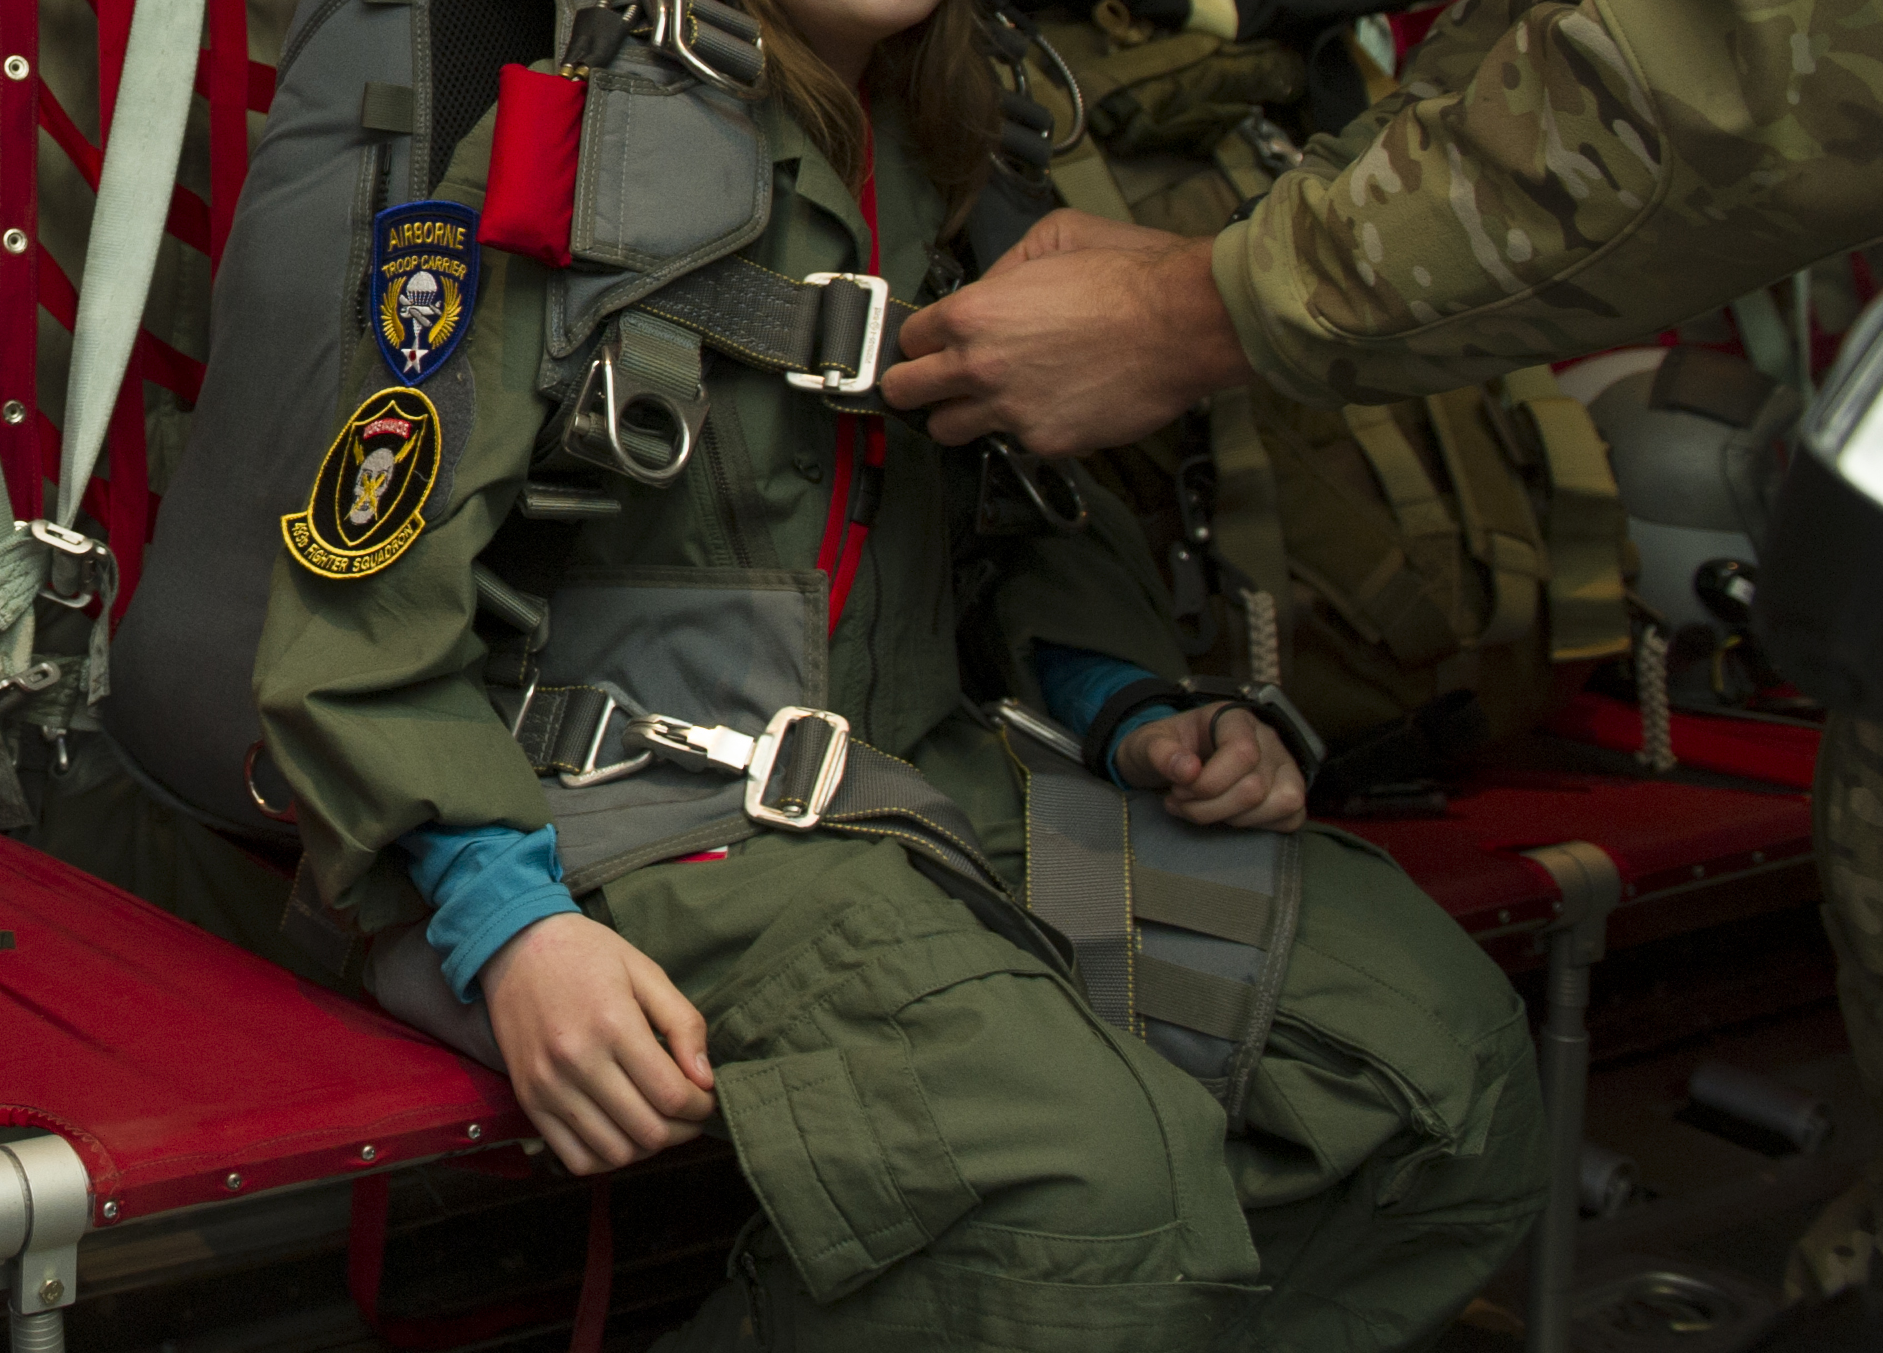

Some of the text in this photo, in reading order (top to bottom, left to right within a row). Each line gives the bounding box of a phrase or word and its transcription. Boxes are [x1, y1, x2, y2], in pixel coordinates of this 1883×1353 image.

[387, 220, 467, 252] AIRBORNE
[381, 253, 468, 280] TROOP CARRIER
[303, 543, 350, 573] FIGHTER
[351, 524, 415, 573] SQUADRON
